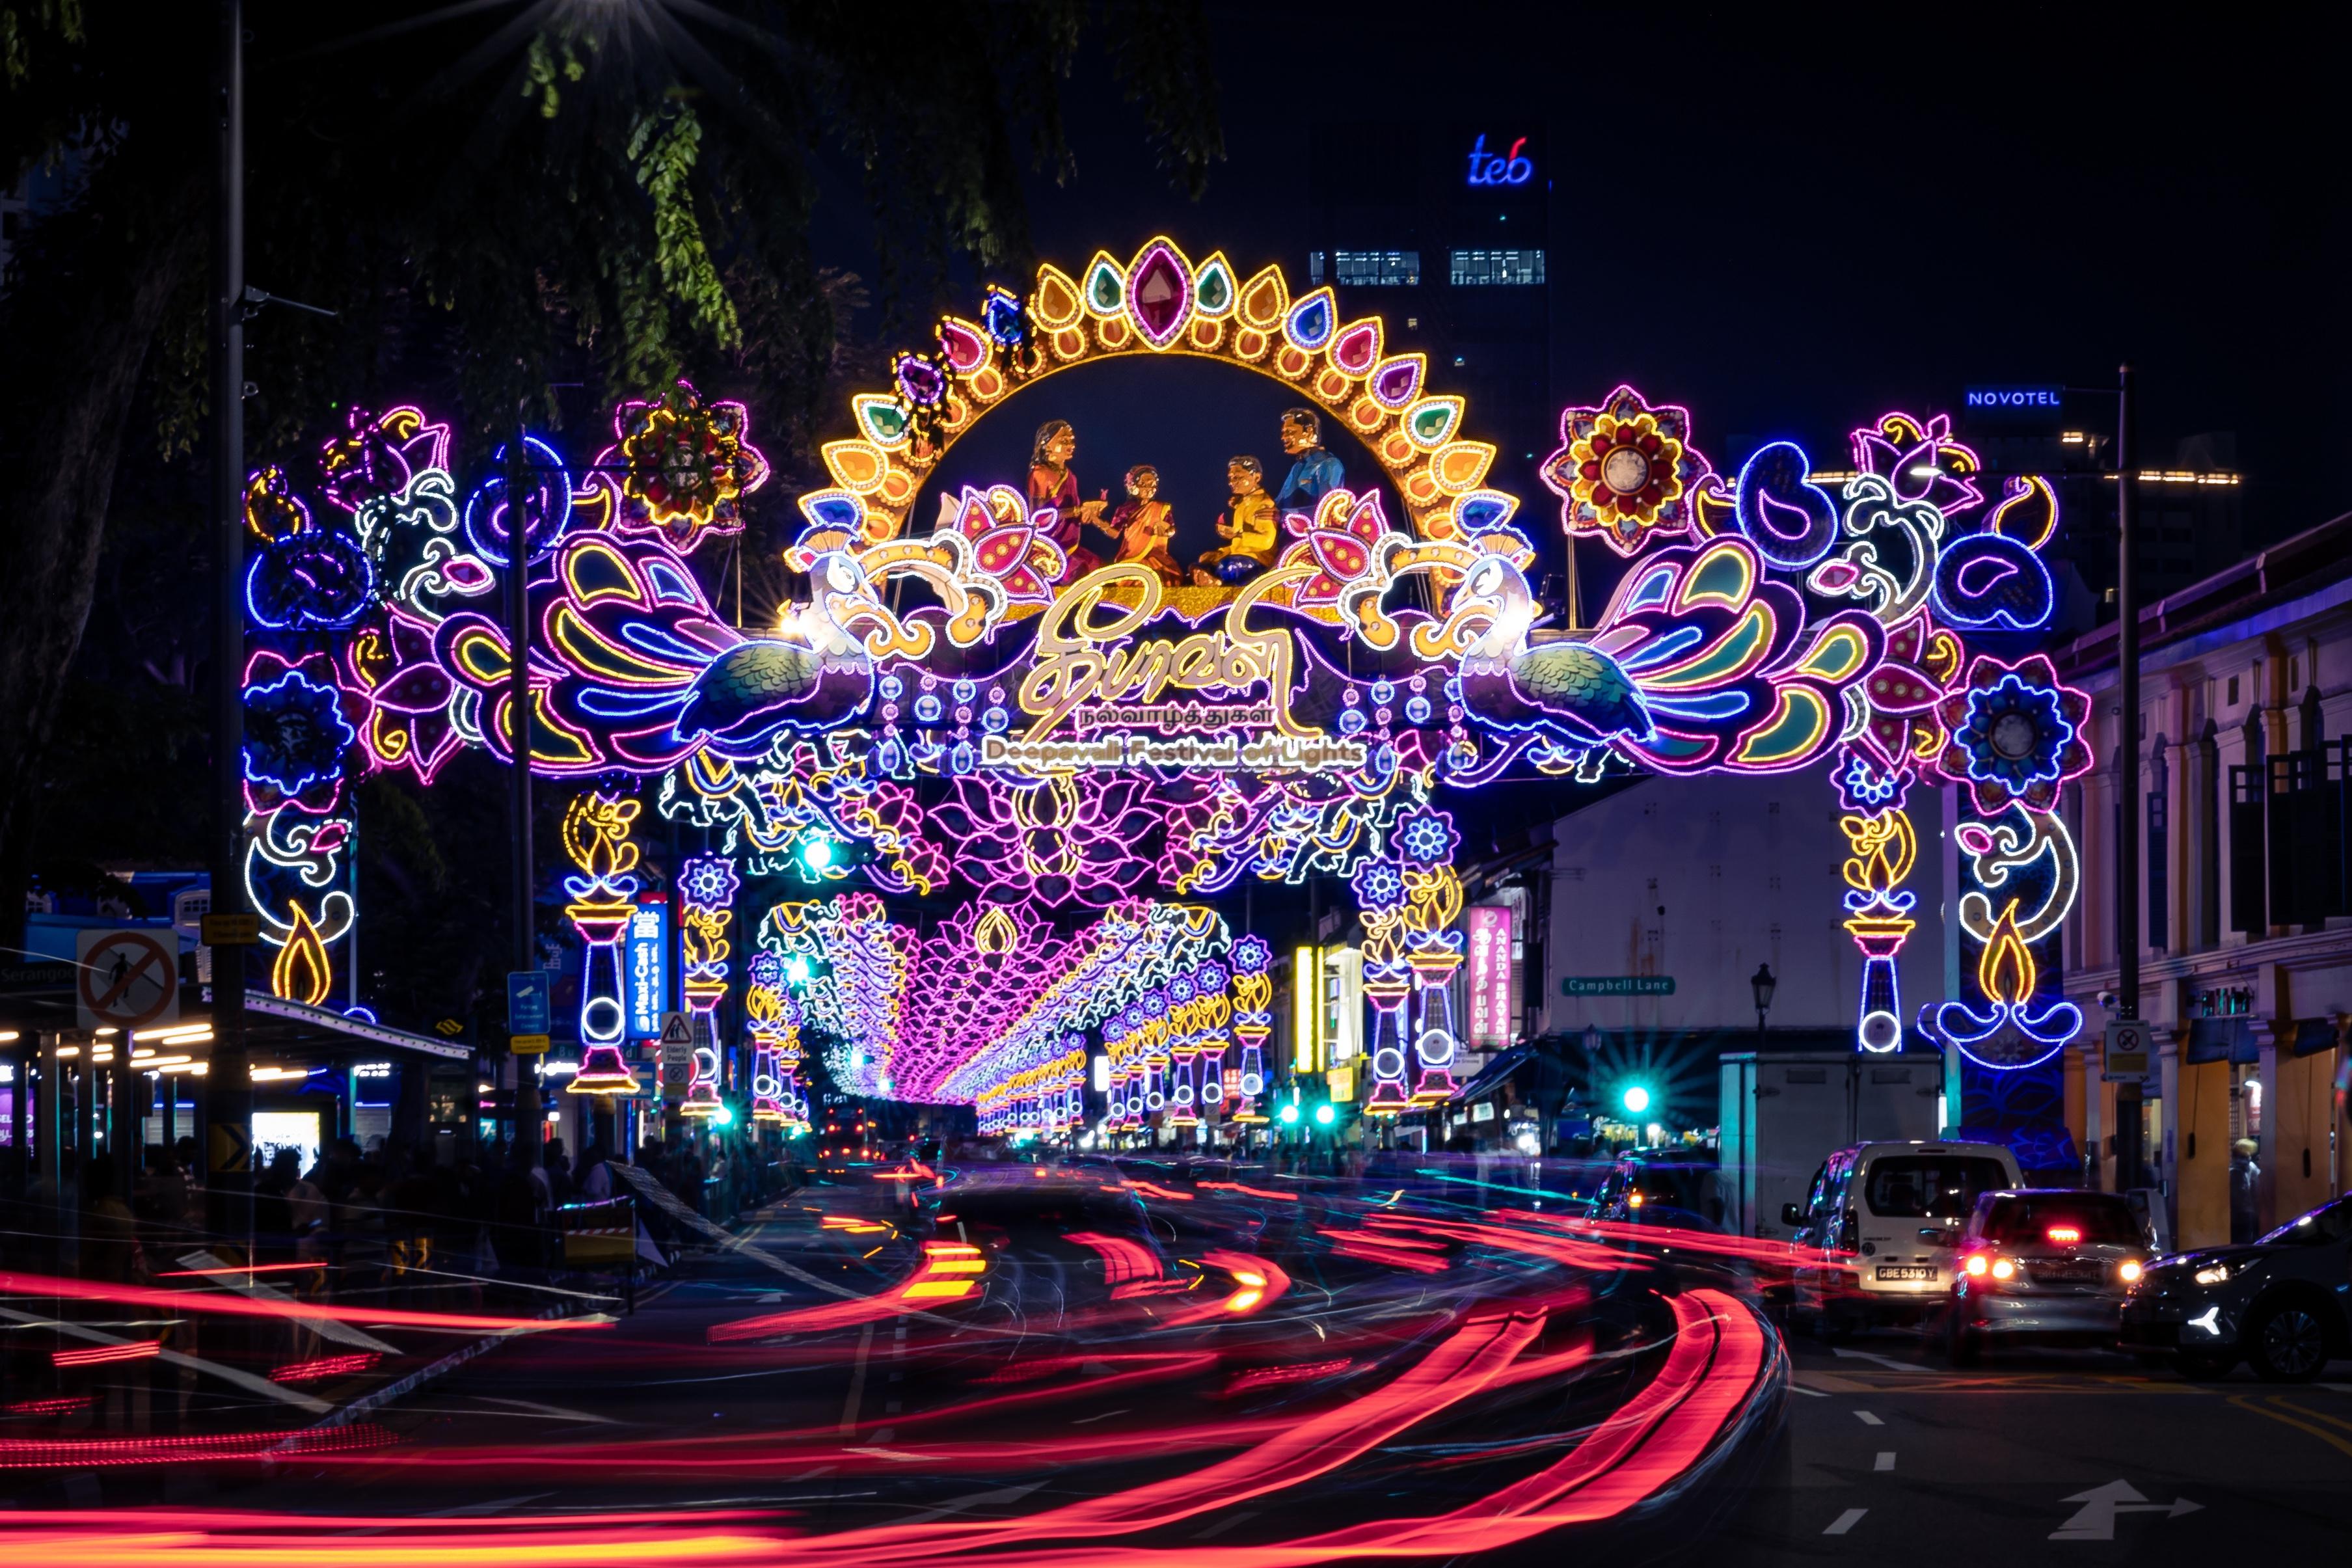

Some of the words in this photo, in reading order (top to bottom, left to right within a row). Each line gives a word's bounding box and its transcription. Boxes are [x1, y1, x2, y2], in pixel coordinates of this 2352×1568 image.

[1968, 391, 2060, 406] NOVOTEL
[986, 739, 1124, 764] Deepavali
[1131, 740, 1235, 763] Festival
[1244, 739, 1273, 762] of
[1281, 739, 1362, 766] Lights
[1495, 928, 1507, 979] ANANDA
[634, 943, 649, 1015] Maxi-Cash
[1569, 979, 1632, 994] Campbell
[1637, 979, 1669, 991] Lane
[1495, 982, 1507, 1034] BHAVAN
[666, 1046, 687, 1054] Elderly
